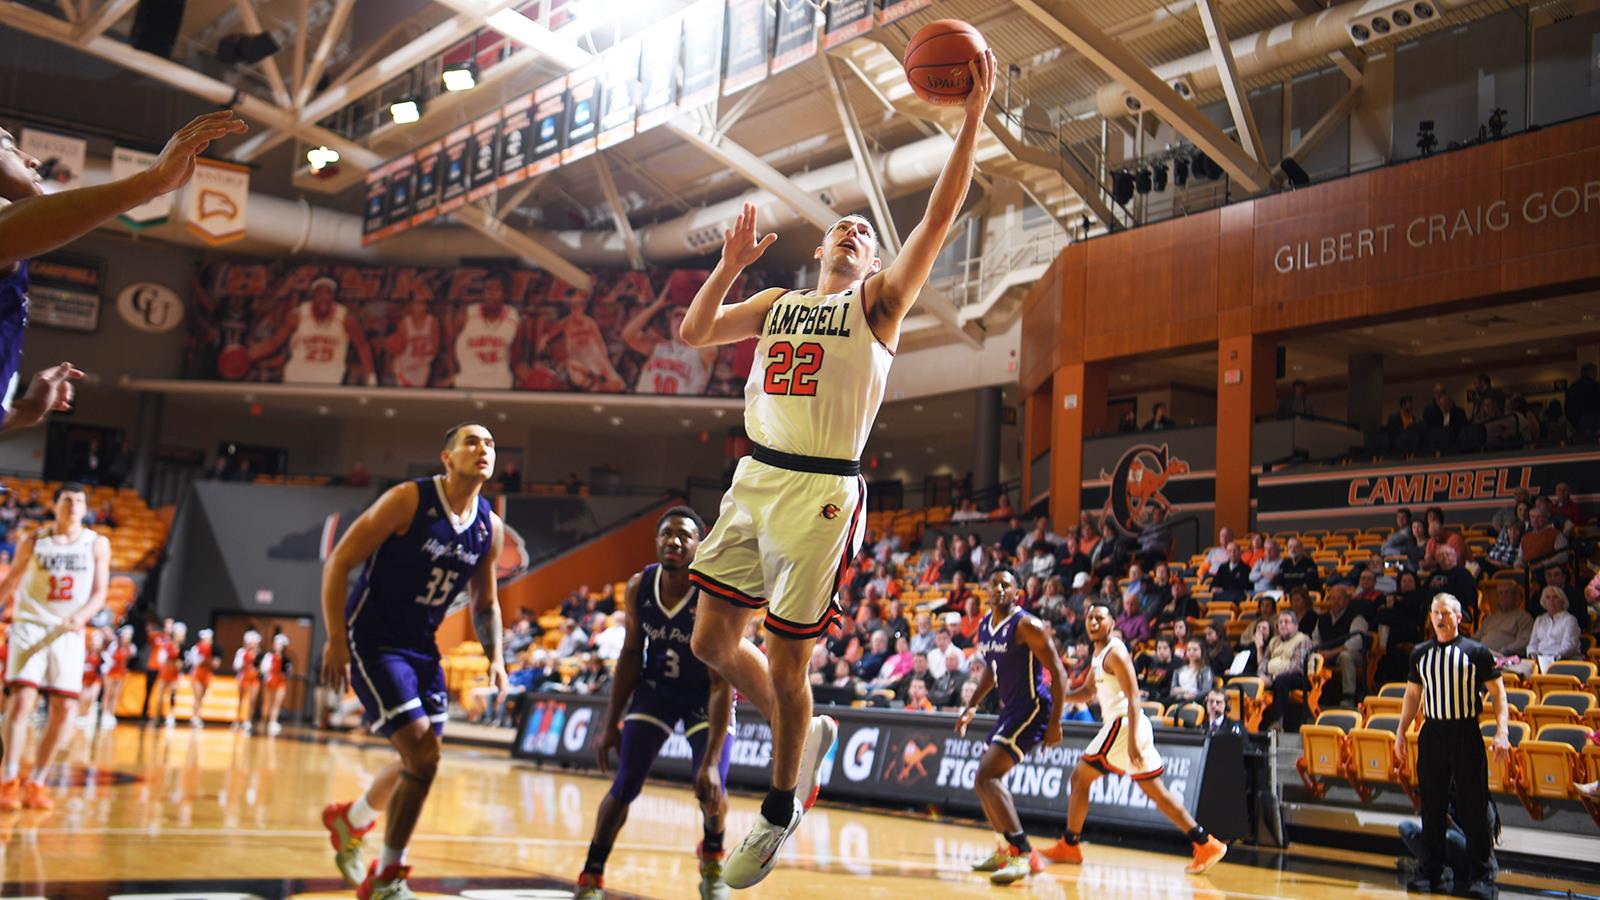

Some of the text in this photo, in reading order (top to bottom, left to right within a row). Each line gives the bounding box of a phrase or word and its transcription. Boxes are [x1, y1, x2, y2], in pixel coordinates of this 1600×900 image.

[1274, 224, 1395, 273] GILBERT
[1406, 201, 1510, 248] CRAIG
[767, 302, 850, 338] AMPBELL
[763, 340, 825, 397] 22
[1348, 466, 1540, 505] CAMPBELL
[46, 574, 74, 602] 12
[415, 567, 460, 606] 35
[668, 627, 691, 644] Poi
[663, 648, 680, 679] 3
[563, 707, 592, 752] G
[842, 727, 881, 782] G
[944, 738, 971, 758] THE
[1034, 746, 1083, 766] SPORT
[936, 757, 1063, 799] FIGTING
